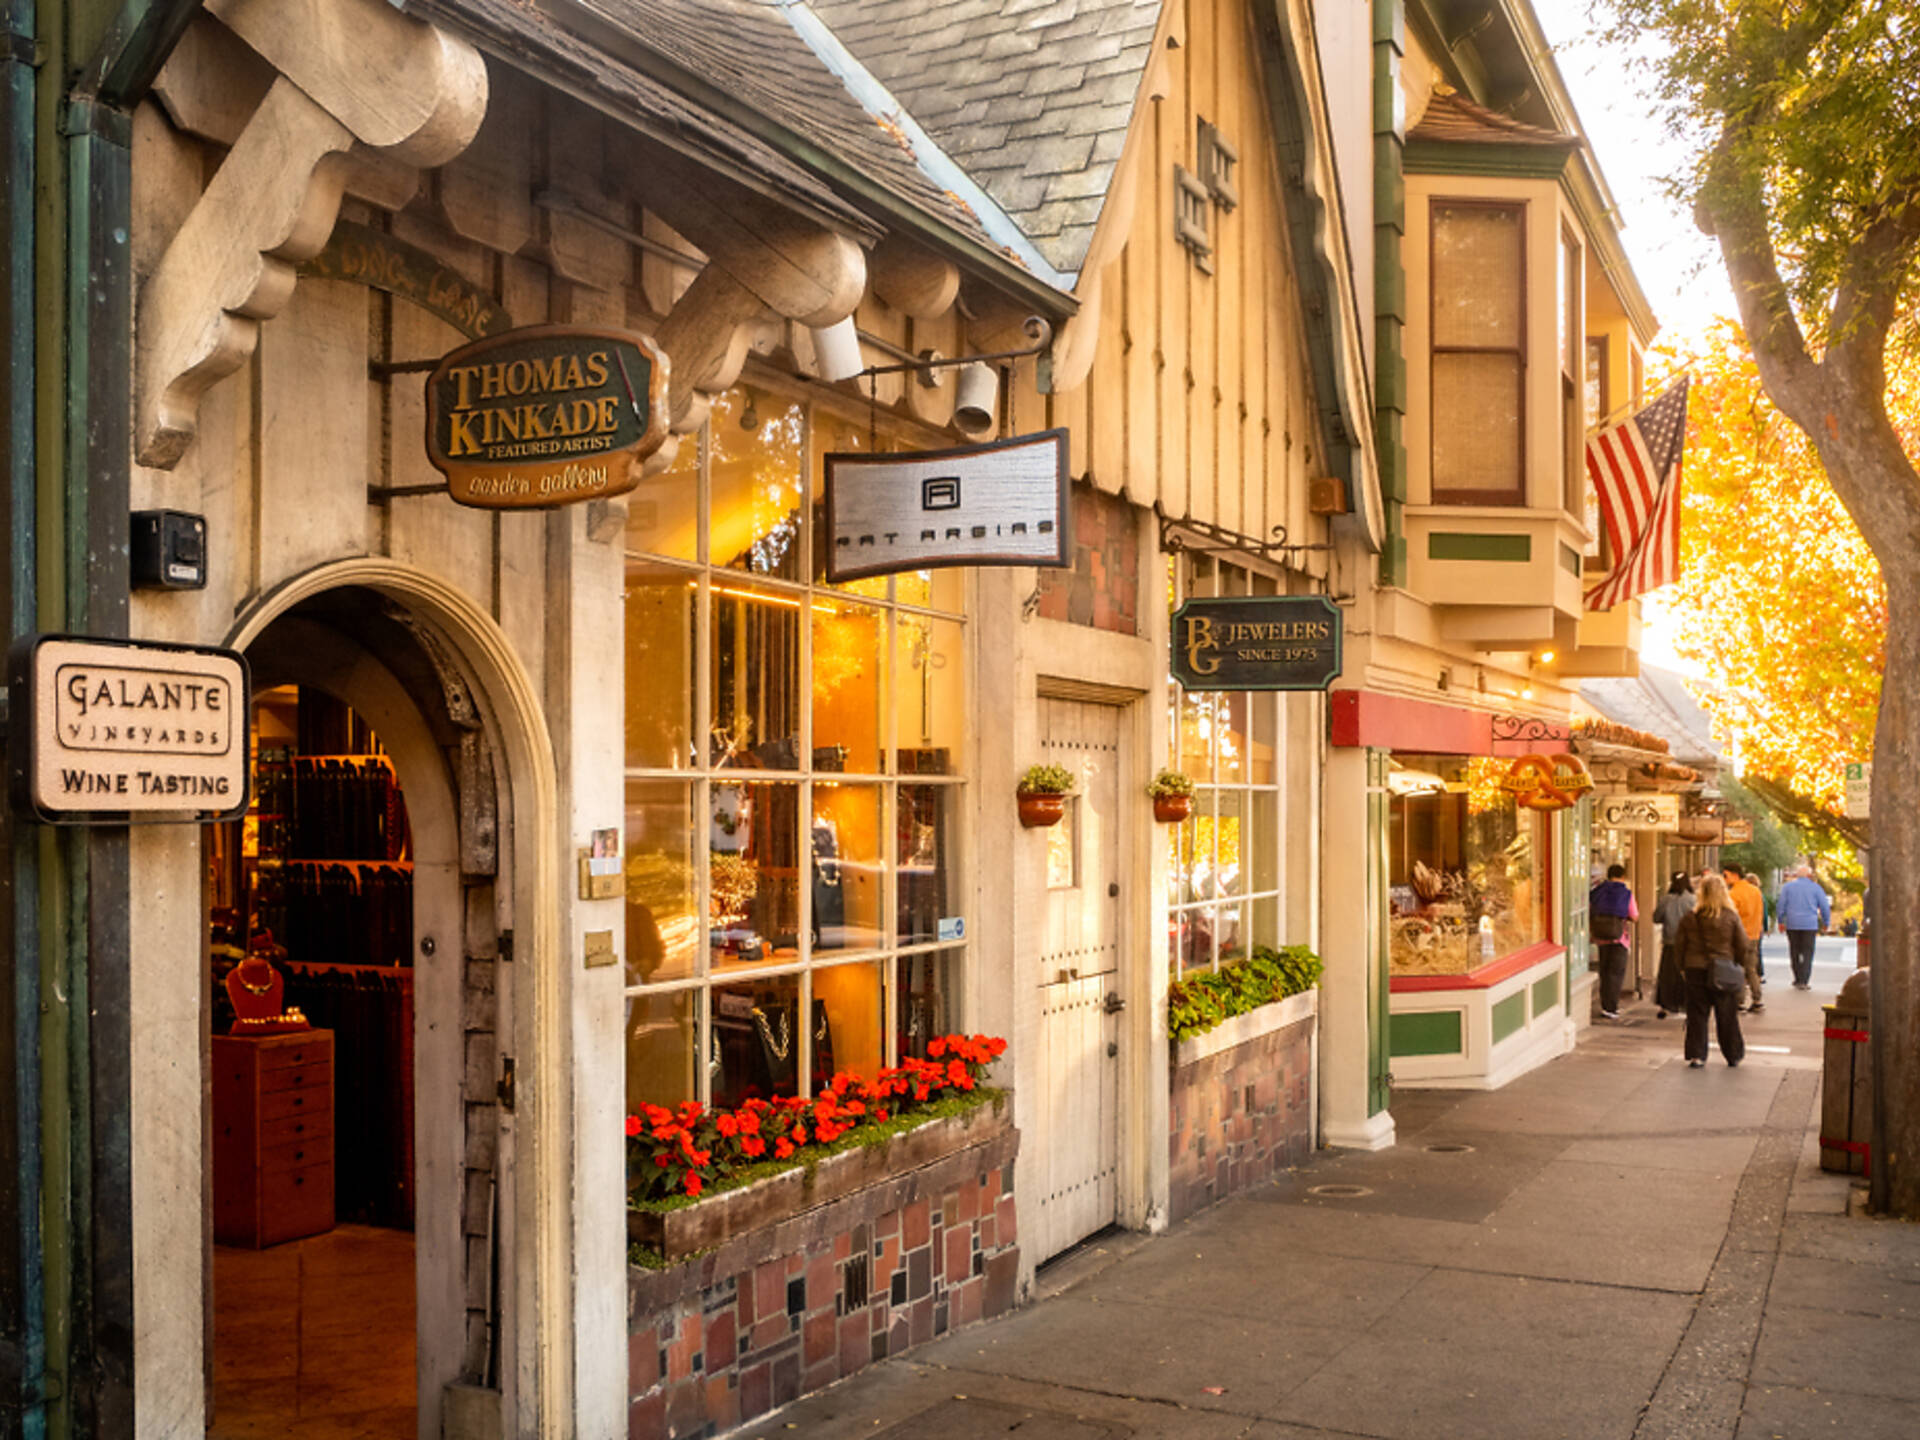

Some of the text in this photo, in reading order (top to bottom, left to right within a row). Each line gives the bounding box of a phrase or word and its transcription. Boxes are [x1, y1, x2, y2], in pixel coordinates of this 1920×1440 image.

[449, 351, 609, 411] THOMAS
[447, 396, 619, 456] KINKADE
[488, 435, 614, 459] FEATURED ARTIST
[467, 463, 607, 497] garden gallery
[1225, 621, 1329, 645] JEWELERS
[1237, 648, 1281, 661] SINCE
[67, 674, 221, 716] GALANTE
[68, 723, 219, 745] VINEYARDS
